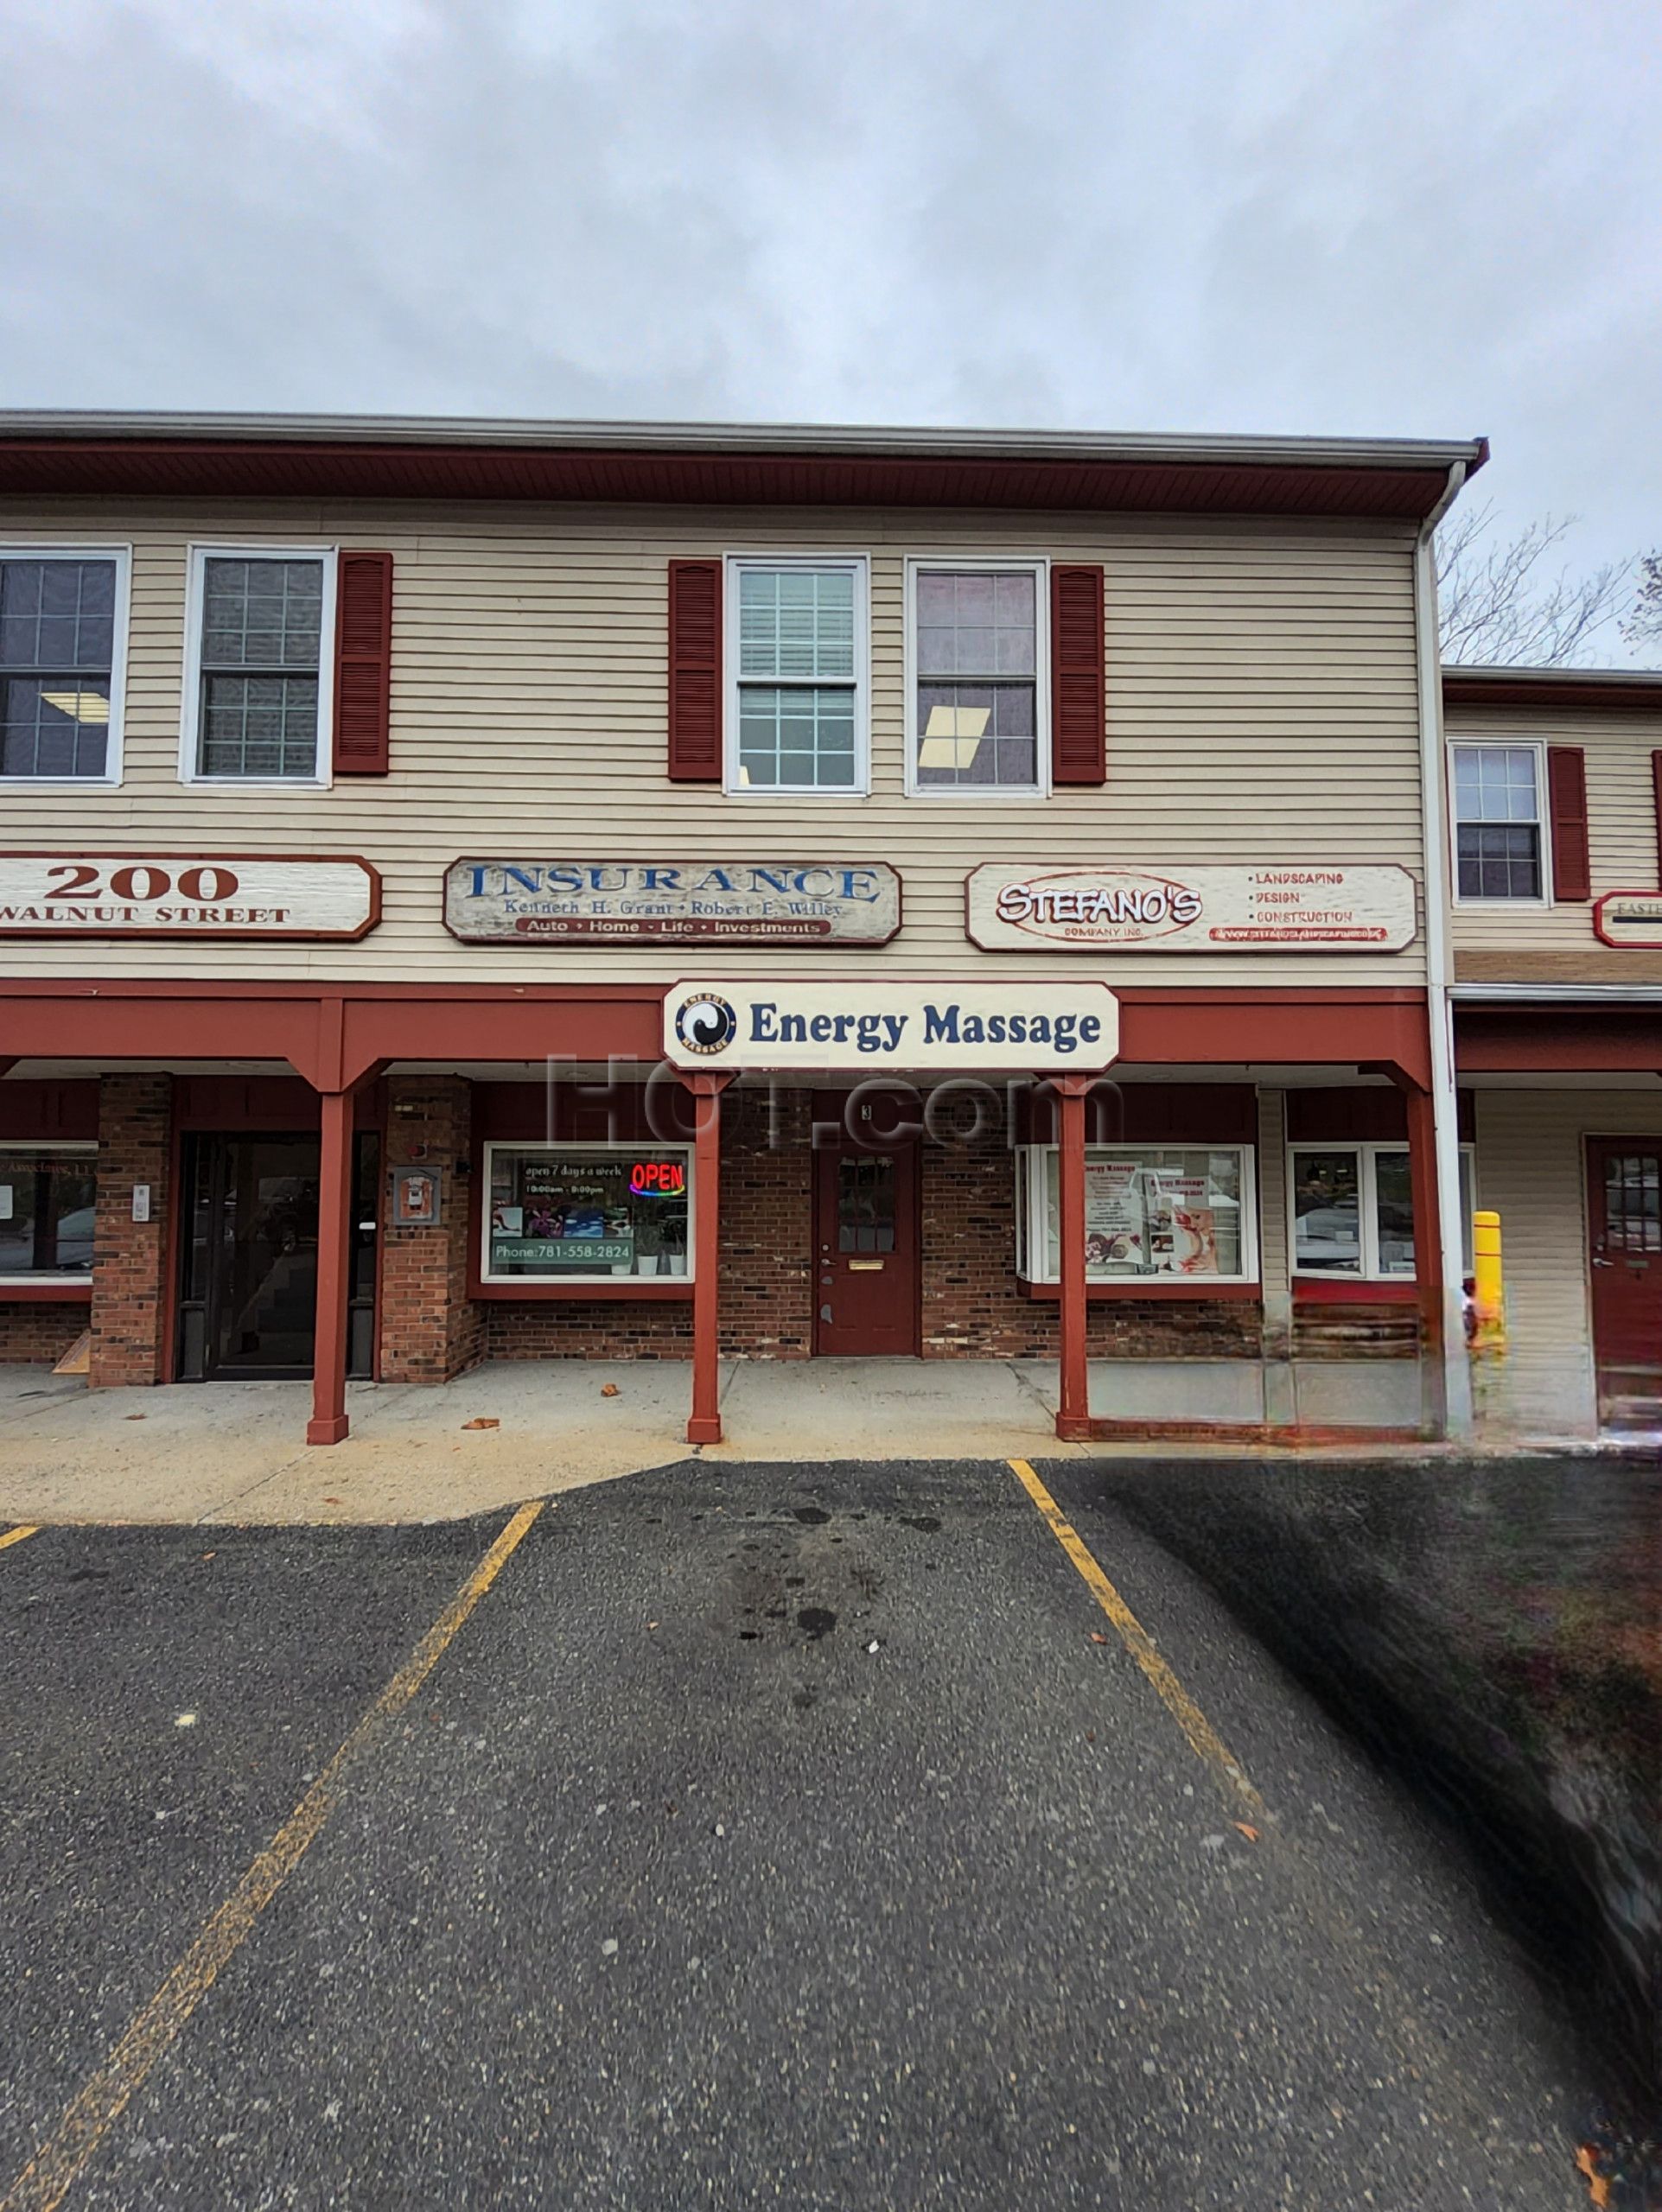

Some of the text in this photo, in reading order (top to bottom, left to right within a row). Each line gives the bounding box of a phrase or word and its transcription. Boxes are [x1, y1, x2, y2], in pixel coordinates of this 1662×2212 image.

[44, 865, 239, 902] 200
[465, 865, 882, 904] INSURANCE
[1256, 873, 1344, 885] LANDSCAPING
[996, 883, 1203, 923] STEFANO'S
[1256, 893, 1300, 904] DESIGN
[0, 906, 290, 923] WALNUT STREET
[504, 899, 579, 914] Kenneth
[591, 900, 612, 914] H.
[621, 900, 673, 915] Grant
[691, 900, 751, 916] Robert
[1258, 912, 1353, 924] CONSTRUCTION
[526, 920, 821, 933] Auto Home Life Investments
[1064, 927, 1120, 937] COMPANY
[748, 1002, 1102, 1053] Energy Massage
[681, 1037, 729, 1053] MASSAGE
[525, 1167, 551, 1179] open
[552, 1165, 559, 1175] 7
[561, 1165, 586, 1179] days
[595, 1165, 622, 1176] week
[631, 1162, 684, 1190] OPEN
